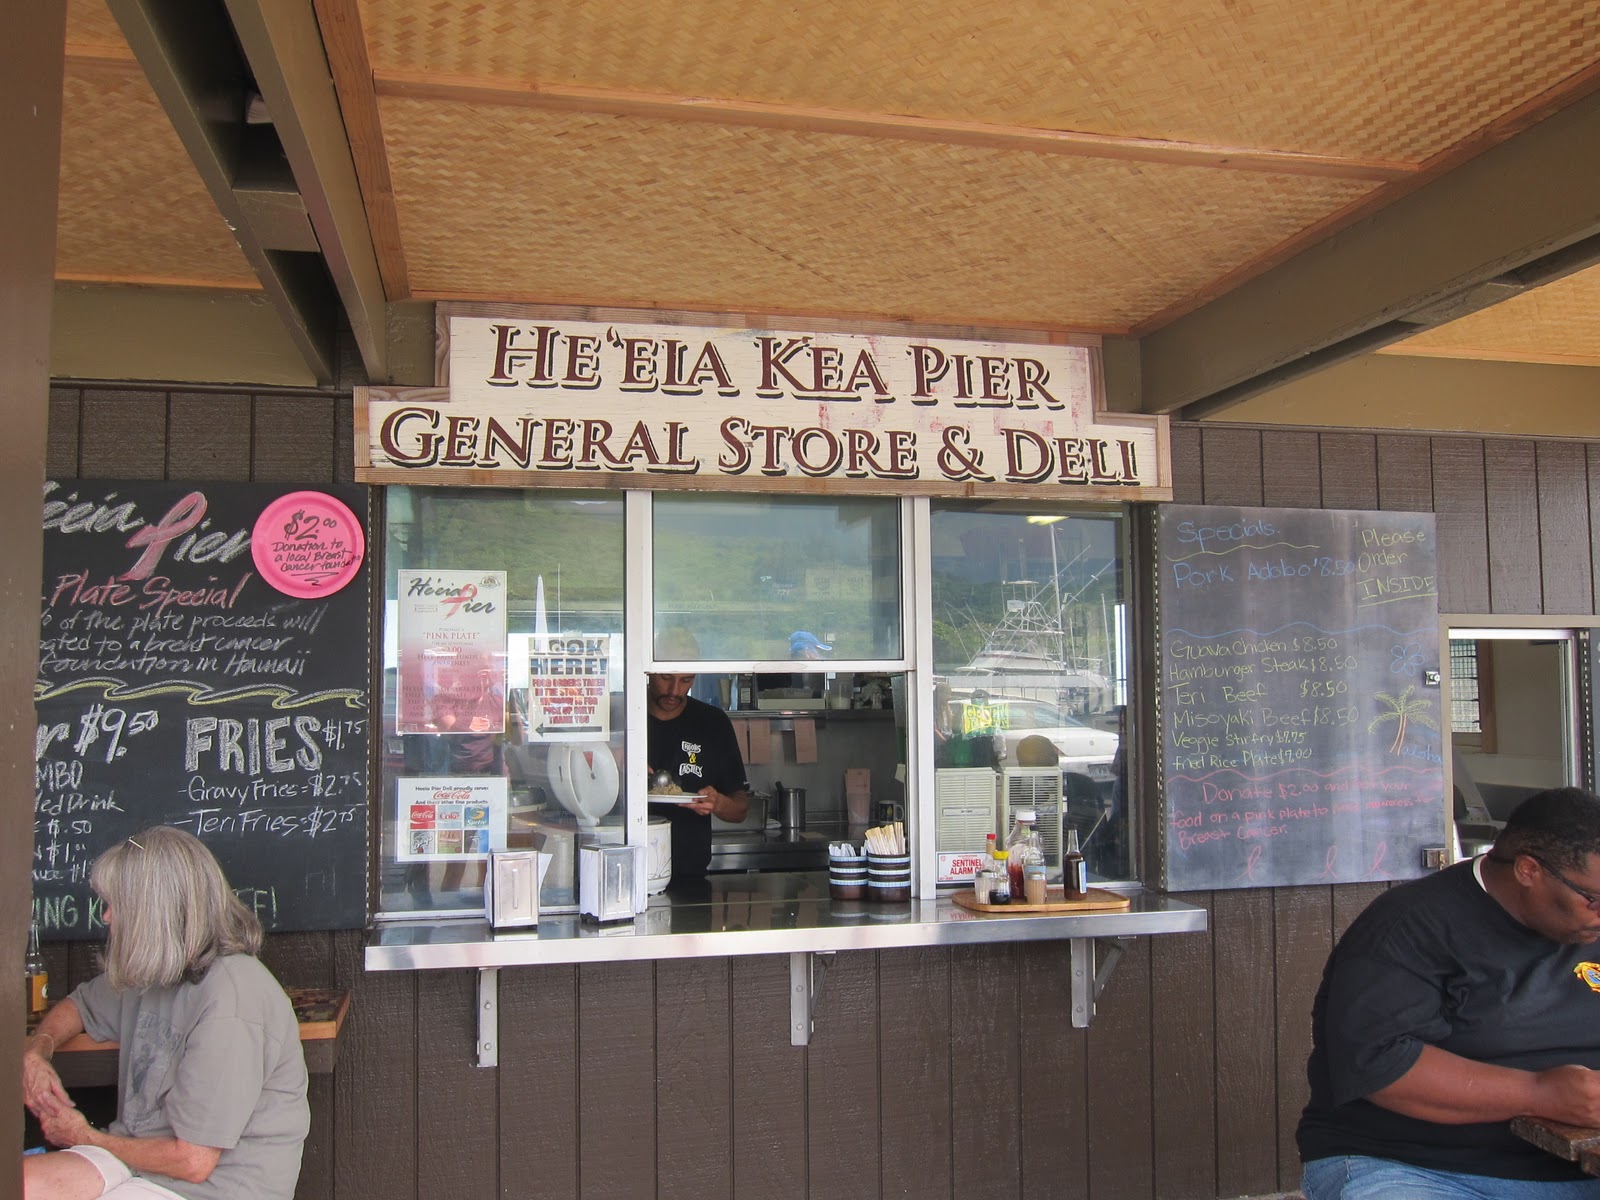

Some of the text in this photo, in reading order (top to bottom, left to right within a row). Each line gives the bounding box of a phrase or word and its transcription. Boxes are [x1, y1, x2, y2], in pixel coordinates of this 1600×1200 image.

[754, 336, 896, 403] KEA
[911, 344, 1065, 410] PIER
[380, 406, 1141, 486] GENERAL STORE & DELI
[272, 538, 344, 552] Donation to
[1361, 528, 1426, 548] Please
[274, 547, 352, 562] a local Breast
[1358, 549, 1408, 572] Order
[1174, 563, 1233, 589] Pork
[1248, 559, 1311, 580] Adobo
[50, 568, 253, 619] Plate Special
[1356, 576, 1436, 600] INSIDE
[60, 610, 83, 629] of
[128, 610, 184, 640] plate
[187, 612, 276, 640] proceeds
[283, 603, 328, 634] will
[94, 636, 122, 656] to
[130, 640, 141, 650] a
[214, 636, 294, 651] cancer
[1170, 637, 1338, 660] Guava Chicken $8.50
[196, 655, 219, 671] in
[224, 650, 311, 676] Hawaii
[531, 659, 607, 675] HERE!
[1170, 656, 1358, 682] Hamburger Steak $8.50
[1168, 679, 1348, 706] Teri Beef $8.50
[1173, 705, 1359, 735] Misoyaki Beef $8.50
[184, 715, 323, 775] FRIES
[1172, 730, 1219, 755] Veggie
[1210, 754, 1238, 768] Rice
[1242, 749, 1279, 767] Plate
[67, 789, 125, 814] Drink
[1202, 783, 1273, 804] Donate
[1279, 783, 1319, 800] $2.00
[1170, 811, 1203, 831] food
[1210, 812, 1228, 824] on
[1232, 811, 1240, 820] a
[1245, 809, 1275, 824] pink
[1280, 807, 1310, 823] plate
[1312, 803, 1328, 817] to
[1178, 828, 1231, 850] Breast
[950, 867, 974, 875] ALARM
[952, 859, 983, 867] SENTINEL
